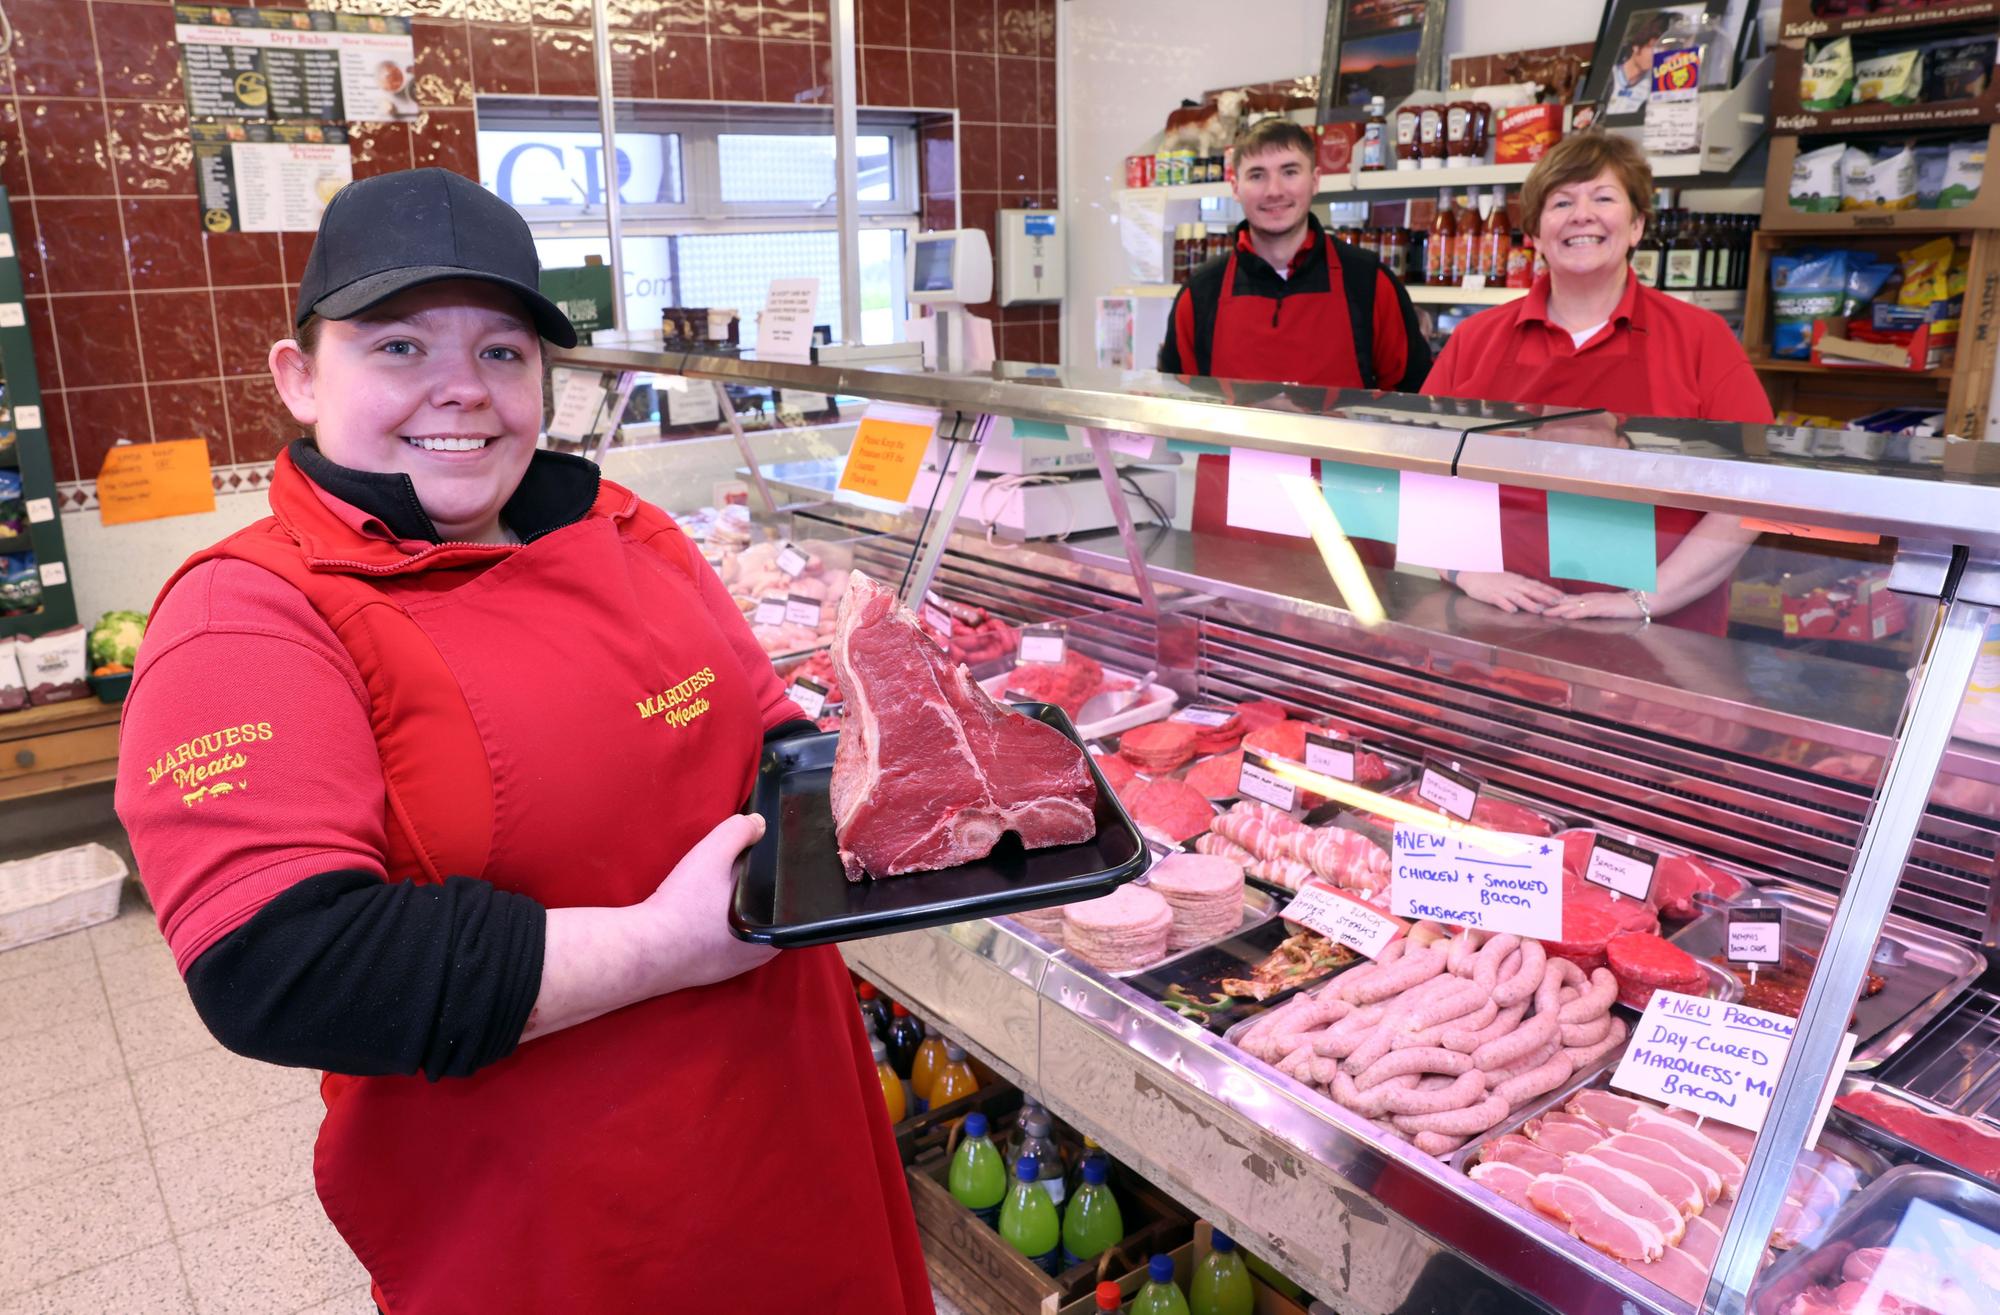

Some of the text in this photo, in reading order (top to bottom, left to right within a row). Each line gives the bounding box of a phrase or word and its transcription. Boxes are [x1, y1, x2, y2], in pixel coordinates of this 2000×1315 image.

[1914, 10, 1945, 21] EXTRA
[636, 667, 716, 719] MARQUESS
[665, 697, 710, 728] Meats
[147, 722, 273, 785] MARQUESS
[172, 752, 248, 789] Meats
[1398, 866, 1459, 883] CHICKEN
[1409, 899, 1483, 927] SAUSAGES!
[1648, 1024, 1769, 1066] DRY-CURED
[1661, 1074, 1738, 1107] BACON
